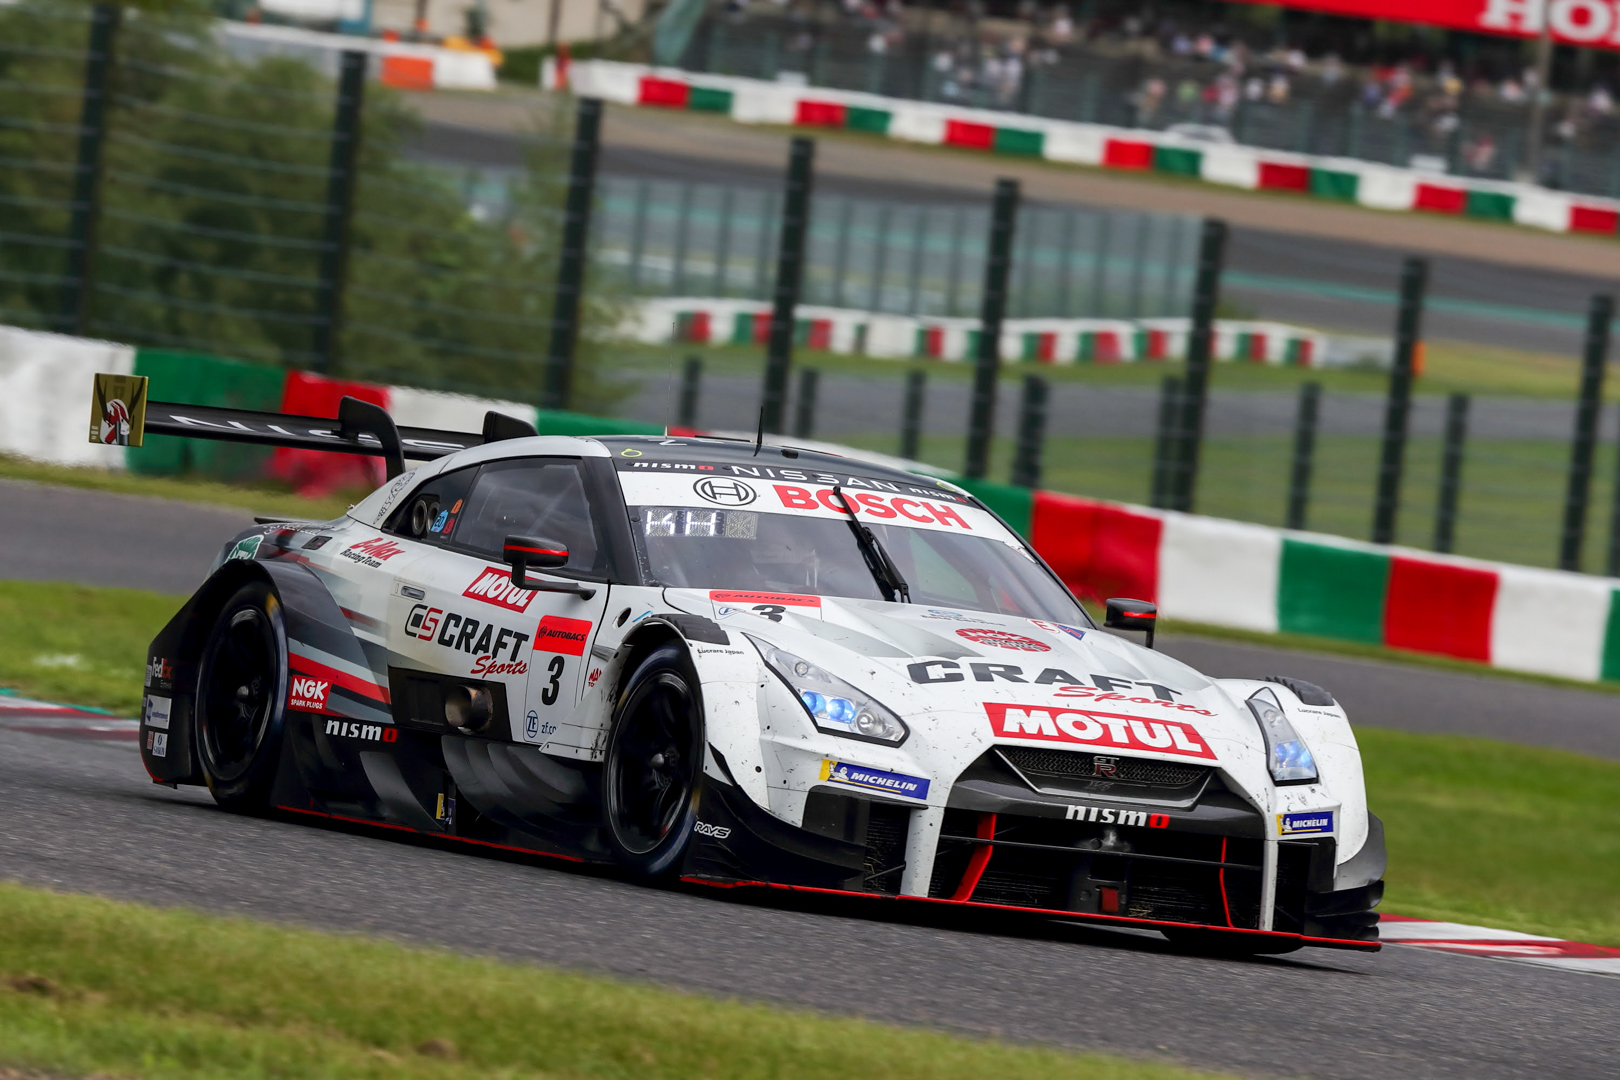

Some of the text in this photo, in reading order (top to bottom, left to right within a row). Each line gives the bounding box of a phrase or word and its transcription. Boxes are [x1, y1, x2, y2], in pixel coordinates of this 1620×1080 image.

[634, 462, 714, 470] nismo
[731, 465, 900, 492] NISSAN
[772, 484, 973, 530] BOSCH
[911, 487, 968, 503] nismo
[340, 548, 366, 563] Racing
[361, 556, 382, 568] Team
[468, 572, 529, 607] MOTUL
[752, 604, 786, 623] 3
[438, 612, 530, 662] CRAFT
[546, 629, 586, 642] AUTOBACS
[470, 655, 528, 679] Sports
[292, 677, 329, 701] NGK
[541, 656, 565, 706] 3
[907, 660, 1183, 702] CRAFT
[291, 699, 323, 710] SPARK PLUGS
[1053, 686, 1219, 718] Sports
[326, 719, 398, 743] nismo
[1003, 708, 1203, 752] MOTUL
[850, 772, 918, 791] MICHELIN
[1066, 805, 1170, 829] nismo
[1292, 819, 1328, 828] MICHELIN
[694, 821, 731, 838] RAYS
